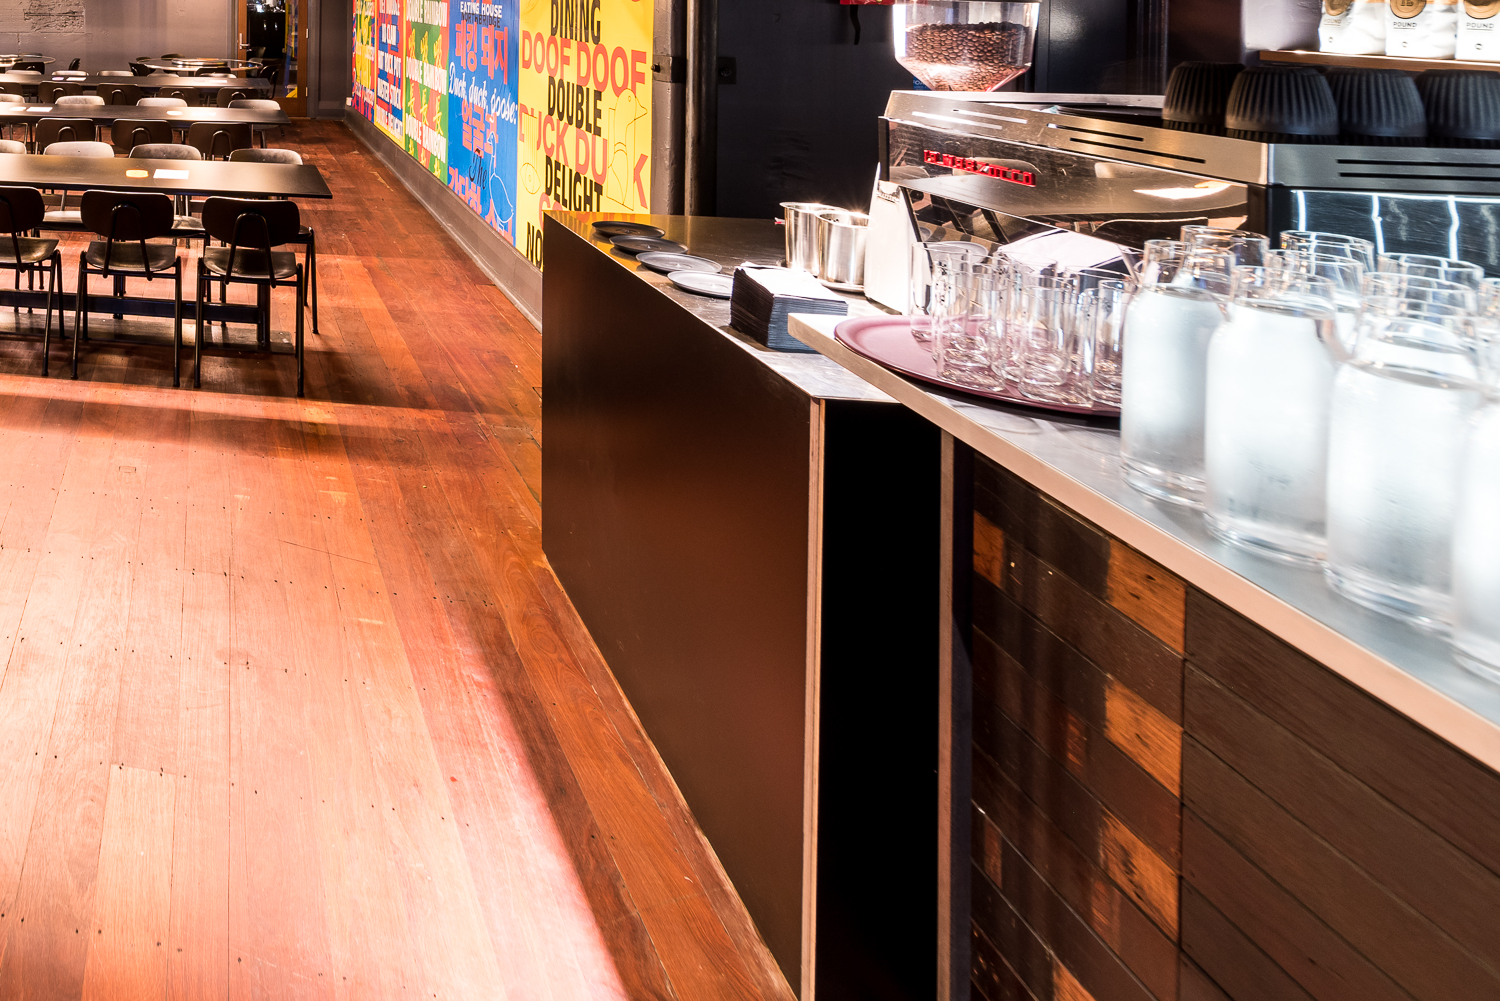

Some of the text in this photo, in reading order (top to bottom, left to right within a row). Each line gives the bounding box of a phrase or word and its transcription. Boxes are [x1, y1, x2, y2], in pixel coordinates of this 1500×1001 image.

[424, 0, 448, 27] RAINBOW
[460, 1, 502, 18] EATING HOUSE
[406, 56, 447, 95] DOUBLE RAINBOW
[449, 62, 467, 99] Duck,
[469, 76, 489, 112] duck,
[522, 30, 647, 97] DOOF DOOF
[548, 76, 602, 136] DOUBLE
[406, 113, 422, 145] DOUBLE
[423, 124, 446, 164] RAINBOW
[469, 148, 487, 190] The
[545, 155, 603, 212] DELIGHT
[575, 127, 648, 209] DUK
